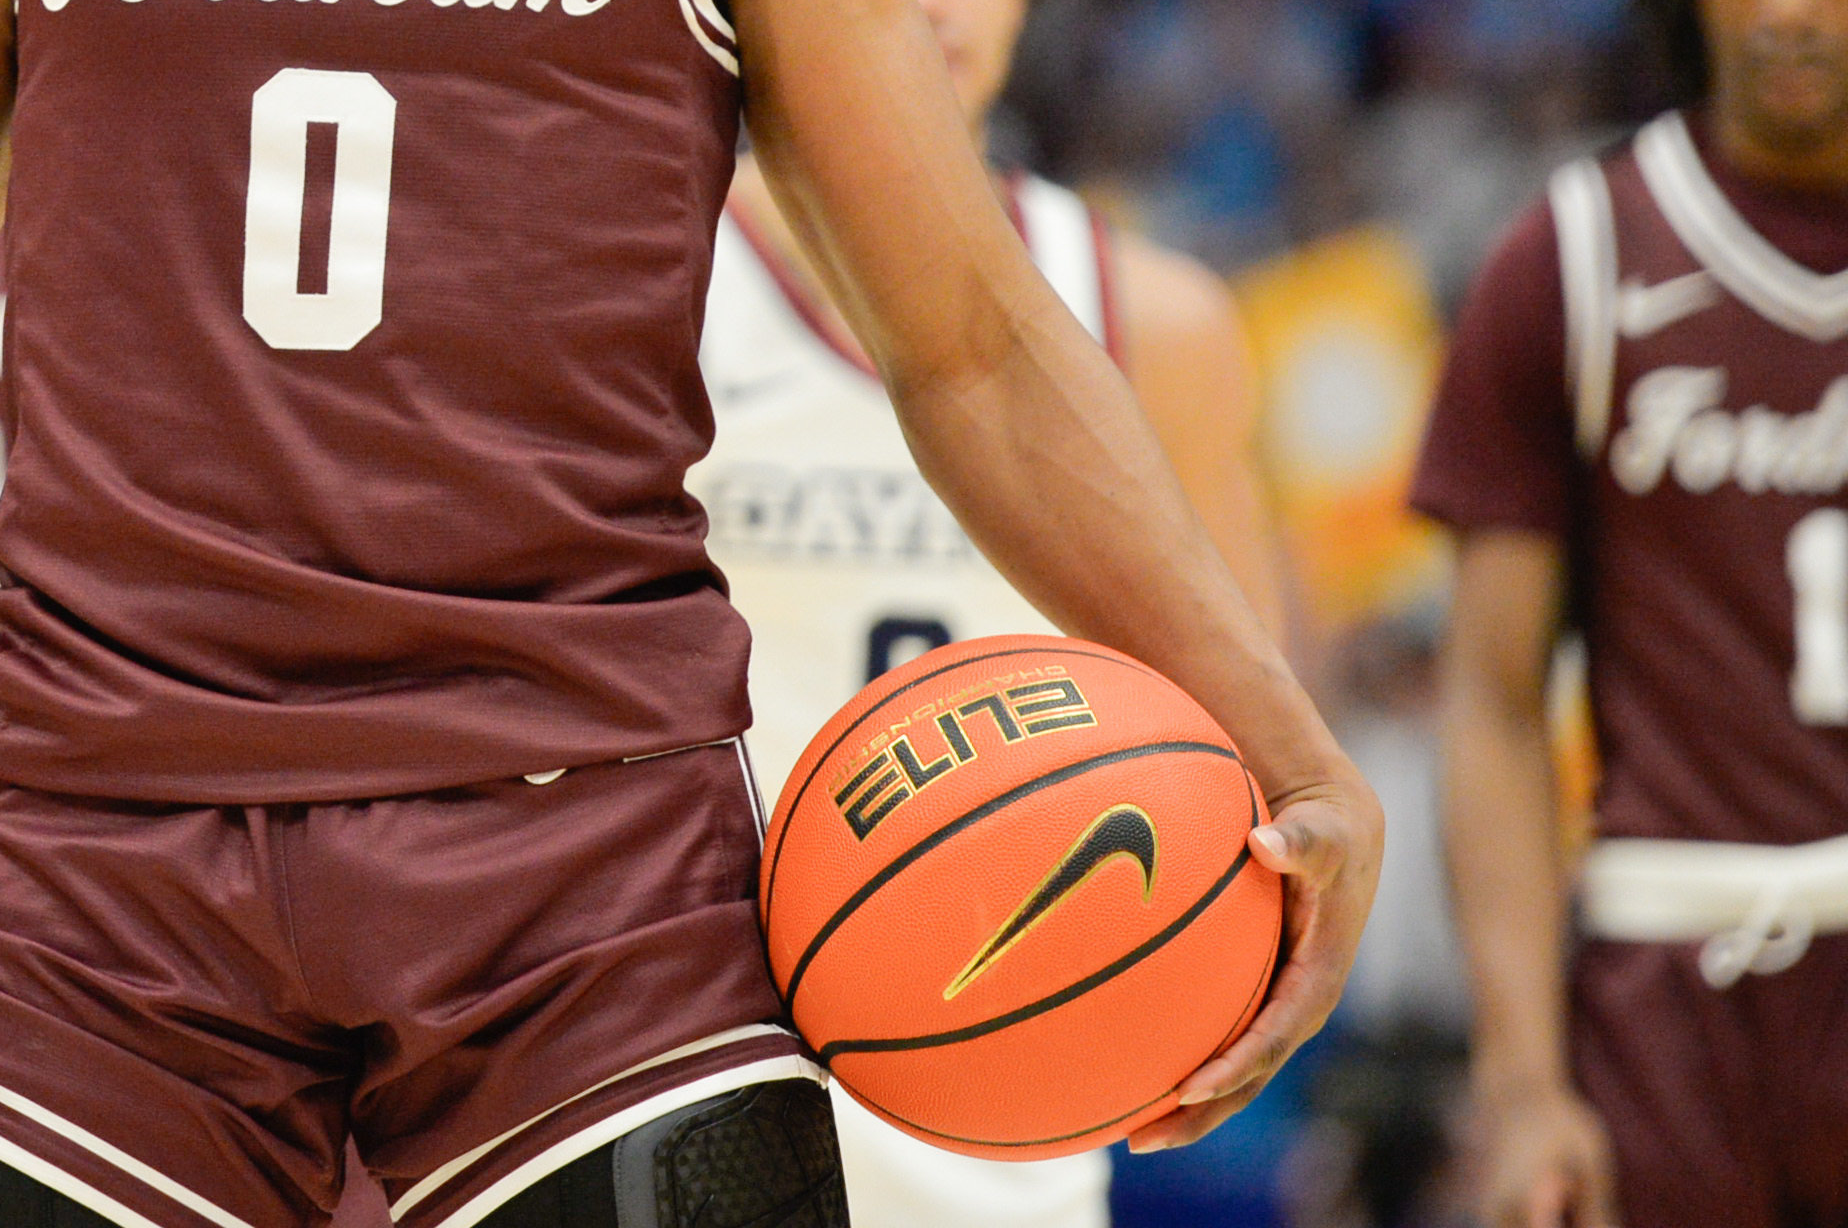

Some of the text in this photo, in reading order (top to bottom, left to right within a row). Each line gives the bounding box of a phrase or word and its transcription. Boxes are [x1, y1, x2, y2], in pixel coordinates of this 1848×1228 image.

[243, 67, 398, 351] 0
[827, 664, 1068, 794] CHAMPIONSHIP
[833, 677, 1099, 843] ELITE
